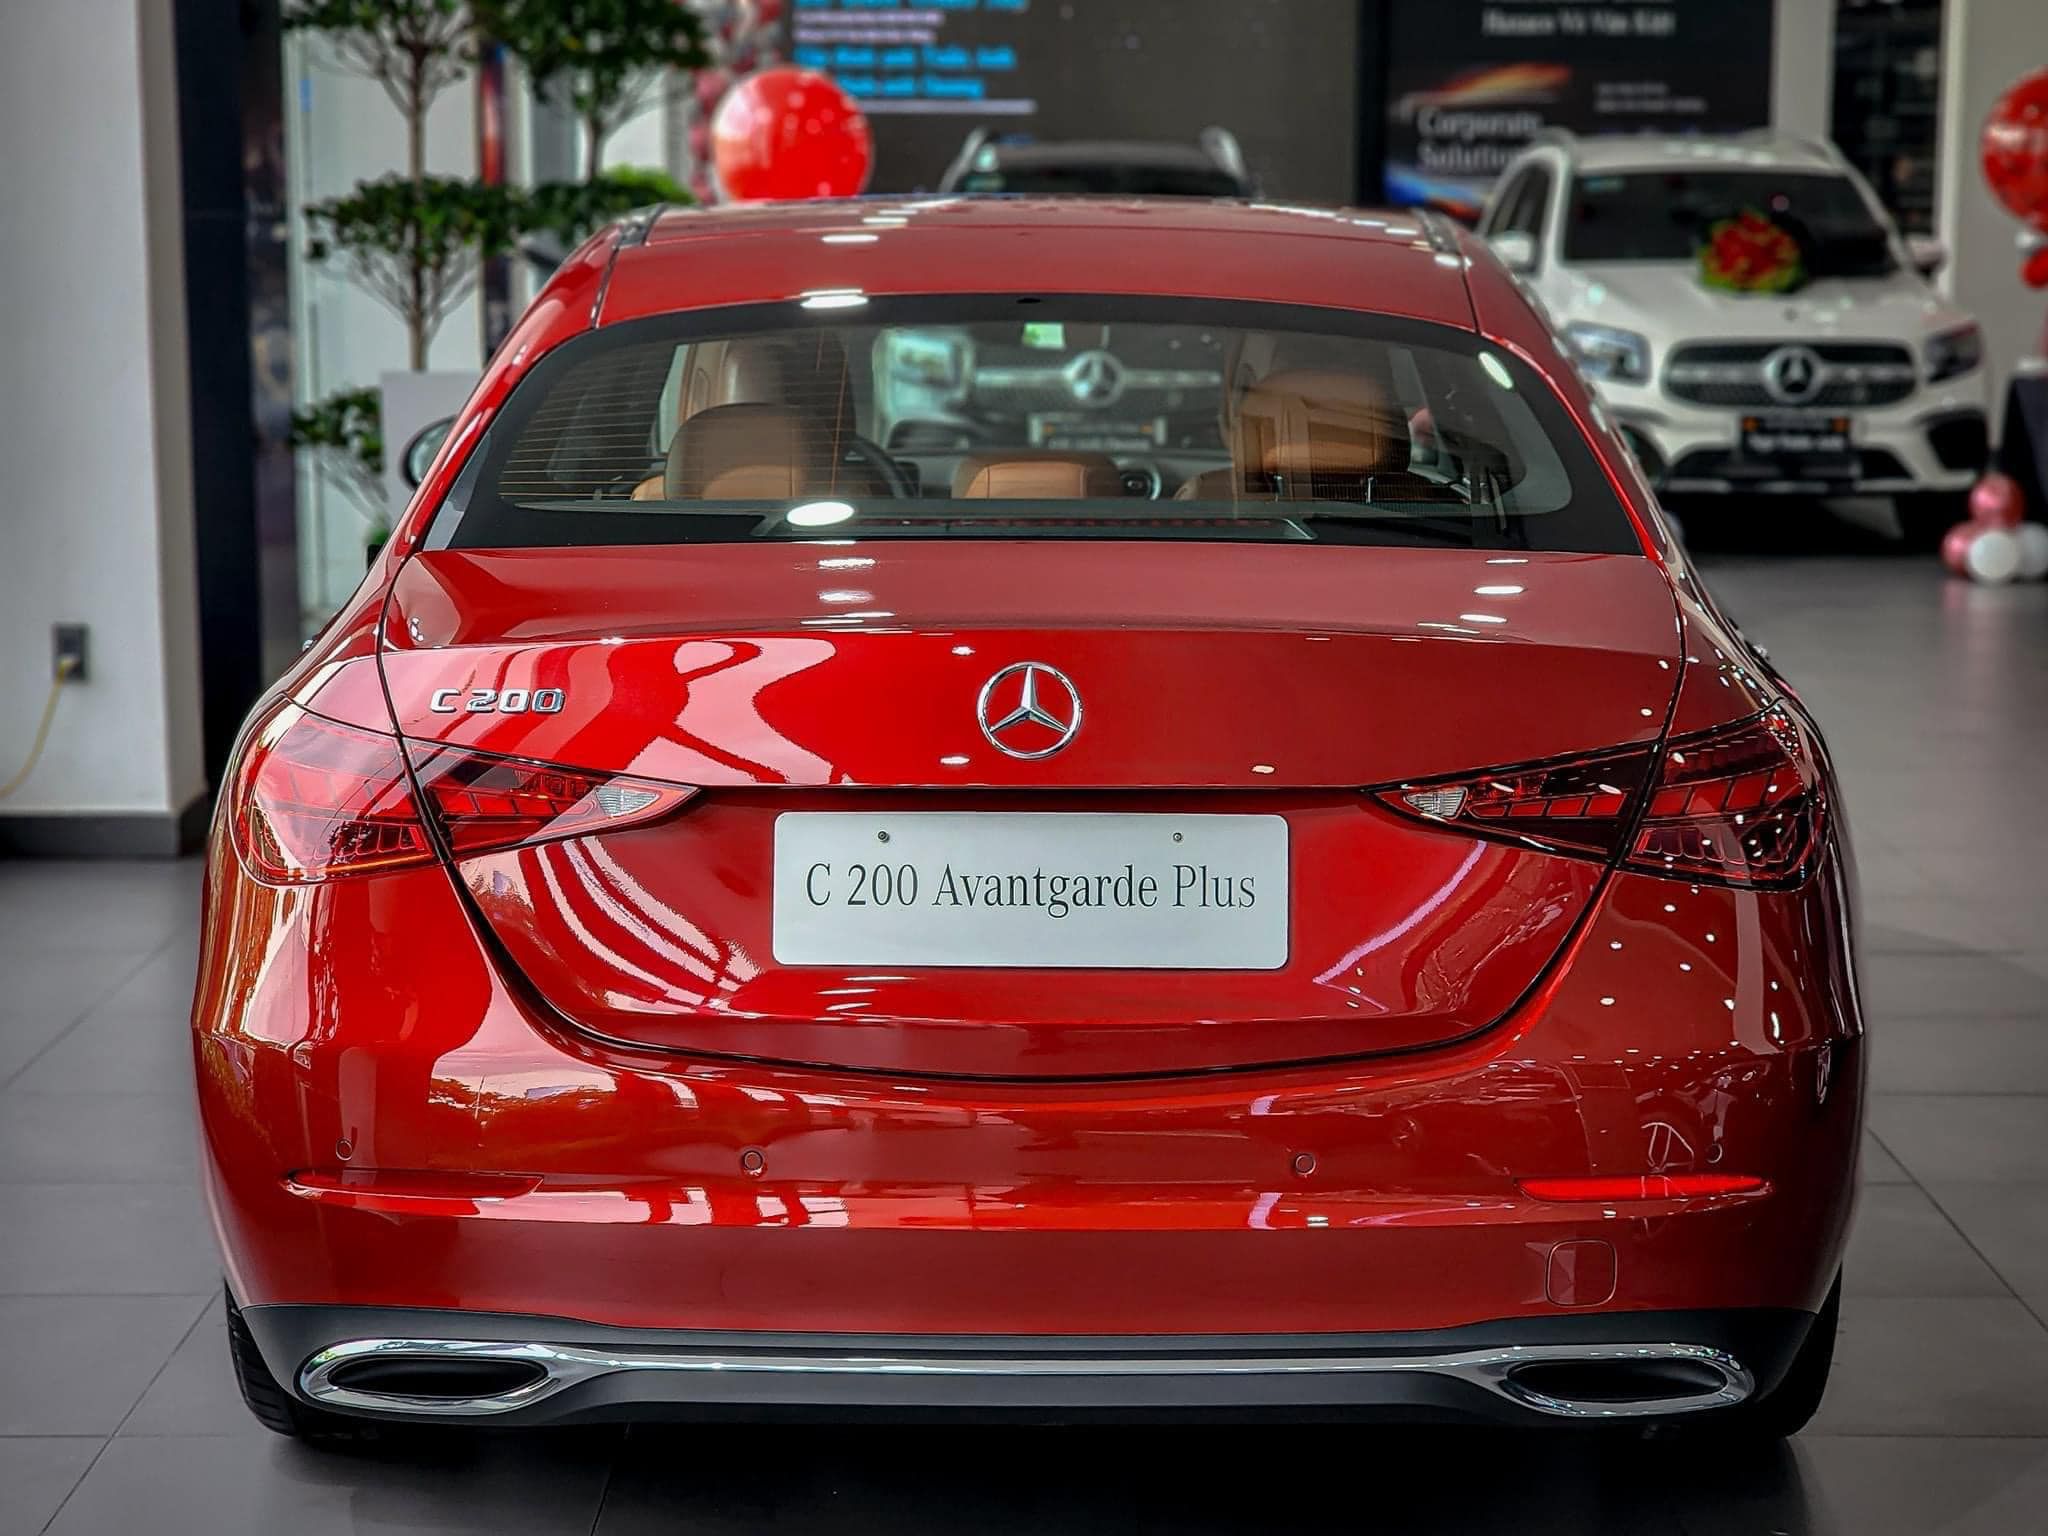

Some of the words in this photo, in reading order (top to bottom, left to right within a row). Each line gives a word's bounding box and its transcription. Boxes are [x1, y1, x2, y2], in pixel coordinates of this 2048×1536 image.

[430, 688, 461, 713] C
[465, 688, 565, 714] 200
[806, 863, 831, 906] C
[847, 863, 918, 906] 200
[931, 863, 1158, 919] Avantgarde
[1171, 864, 1256, 909] Plus
